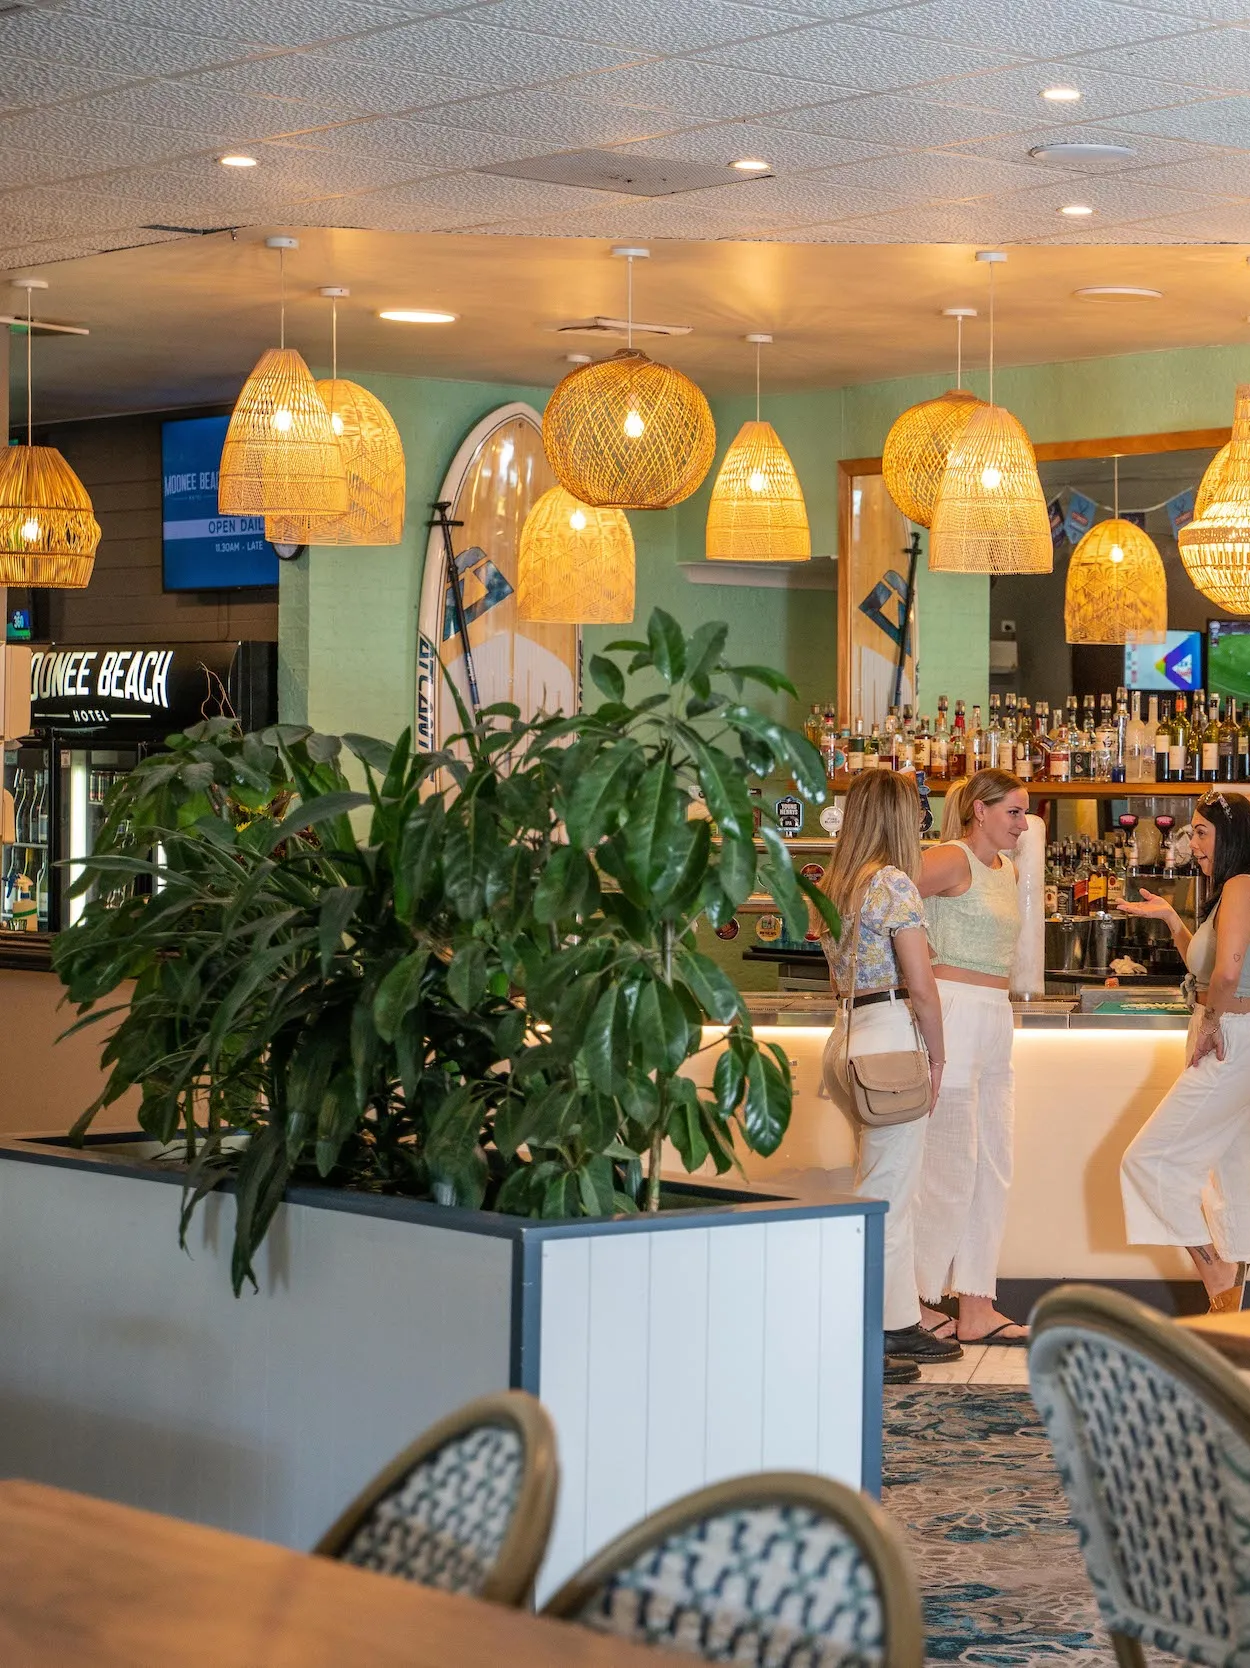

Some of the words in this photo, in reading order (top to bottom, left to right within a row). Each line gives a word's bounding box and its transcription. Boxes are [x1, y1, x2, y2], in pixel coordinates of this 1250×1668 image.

[164, 472, 197, 496] MOONEE
[199, 471, 220, 490] BEA
[208, 520, 236, 534] OPEN
[240, 517, 264, 531] DAIL
[246, 541, 263, 551] LATE
[30, 651, 98, 702] OONEE
[97, 651, 174, 708] BEACH
[73, 709, 110, 722] HOTEL
[418, 636, 435, 782] ATLANT
